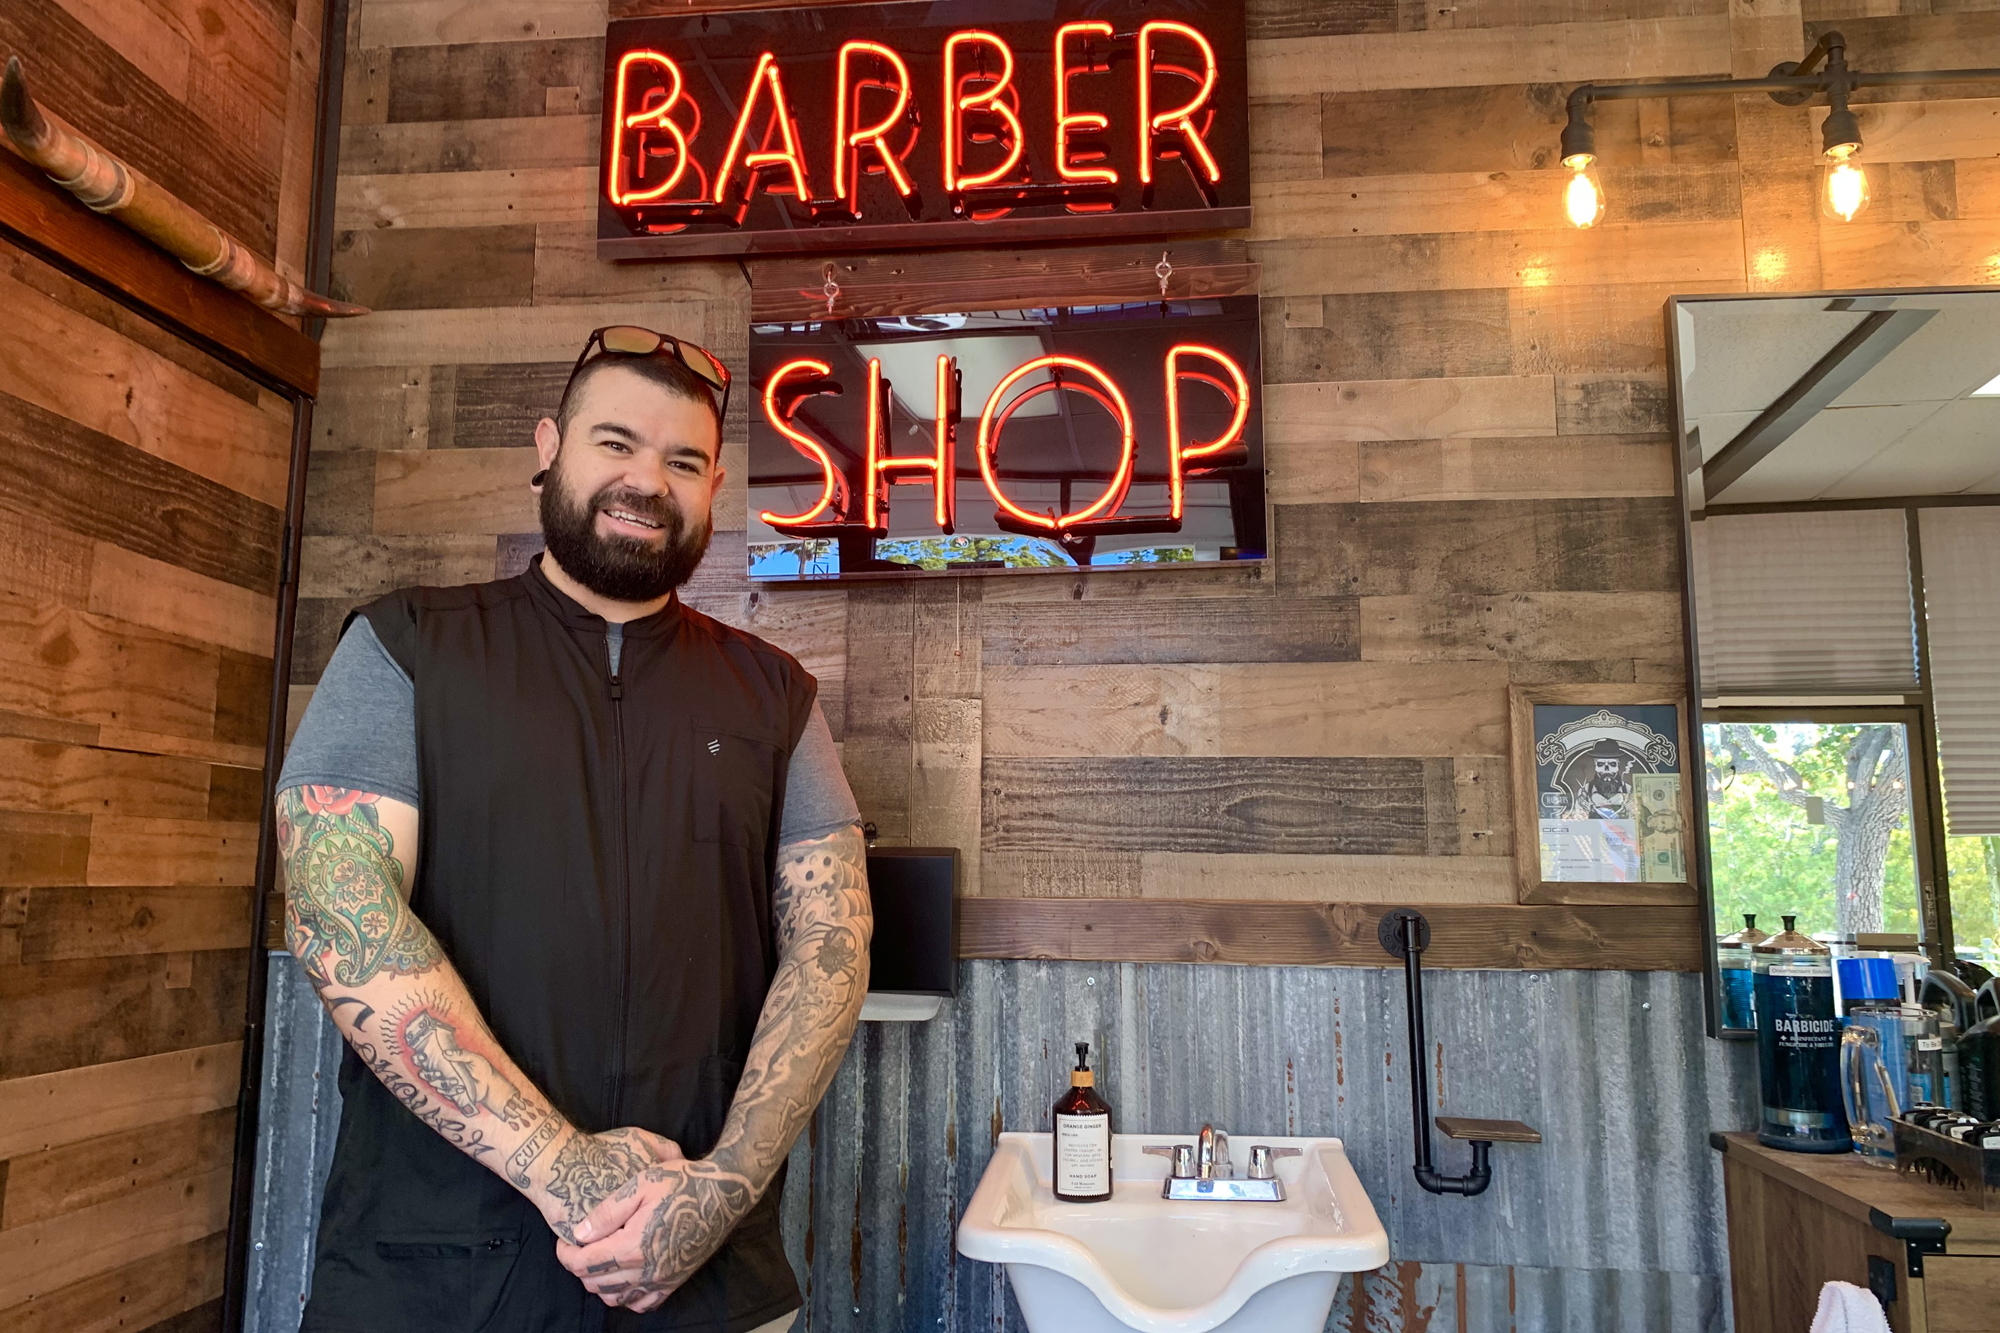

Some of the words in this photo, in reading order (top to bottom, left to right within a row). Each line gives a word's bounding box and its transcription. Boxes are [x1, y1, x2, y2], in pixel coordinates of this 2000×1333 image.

[609, 20, 1220, 206] BARBER
[759, 344, 1250, 530] SHOP
[1775, 1019, 1834, 1033] BARBICIDE
[515, 1135, 540, 1167] CUT
[539, 1122, 557, 1141] OR
